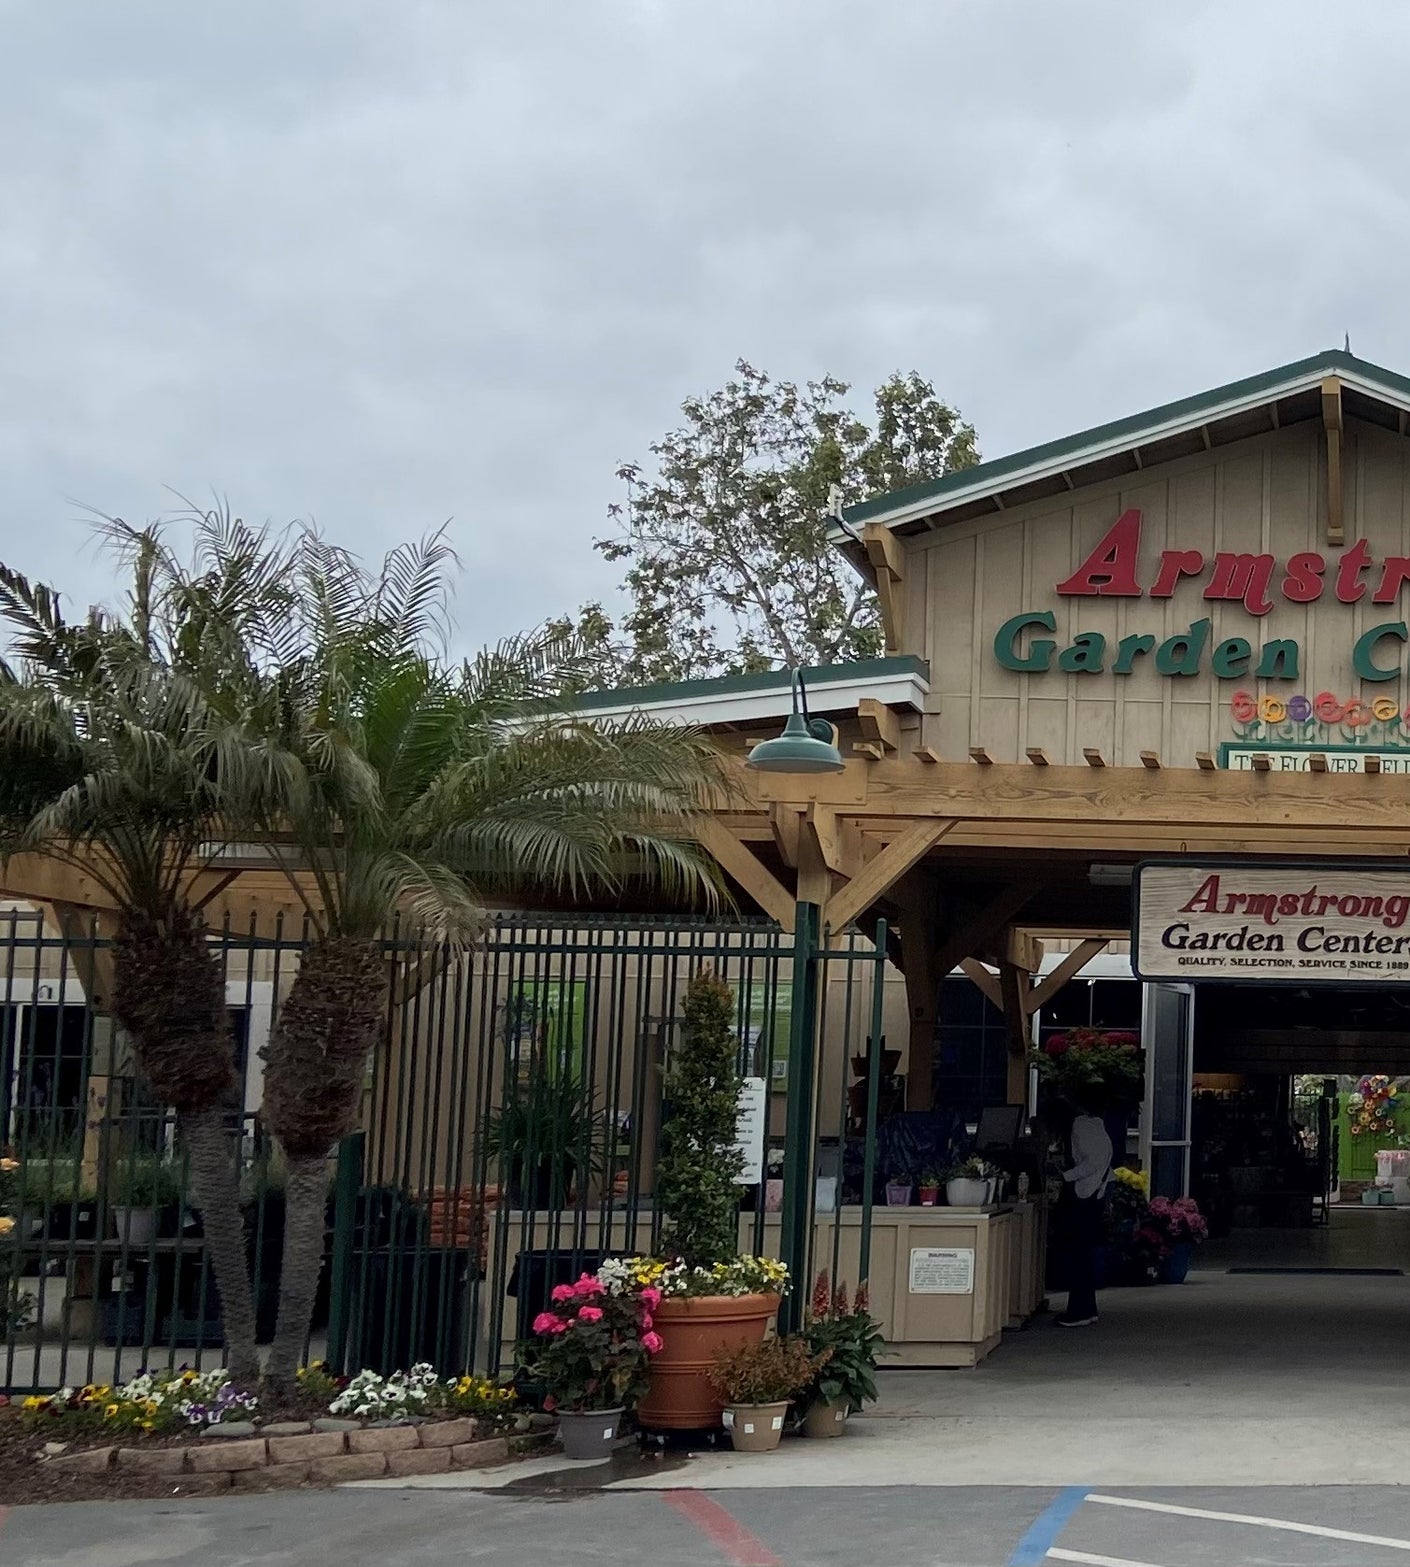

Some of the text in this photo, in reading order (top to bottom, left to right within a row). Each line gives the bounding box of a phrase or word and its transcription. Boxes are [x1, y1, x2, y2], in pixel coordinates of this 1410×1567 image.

[992, 611, 1301, 680] Garden
[1160, 922, 1285, 953] Garden
[1177, 956, 1227, 967] QUALITY,
[1230, 957, 1296, 968] SELECTION,
[1299, 959, 1346, 968] SERVICE
[1350, 960, 1383, 969] SINCE
